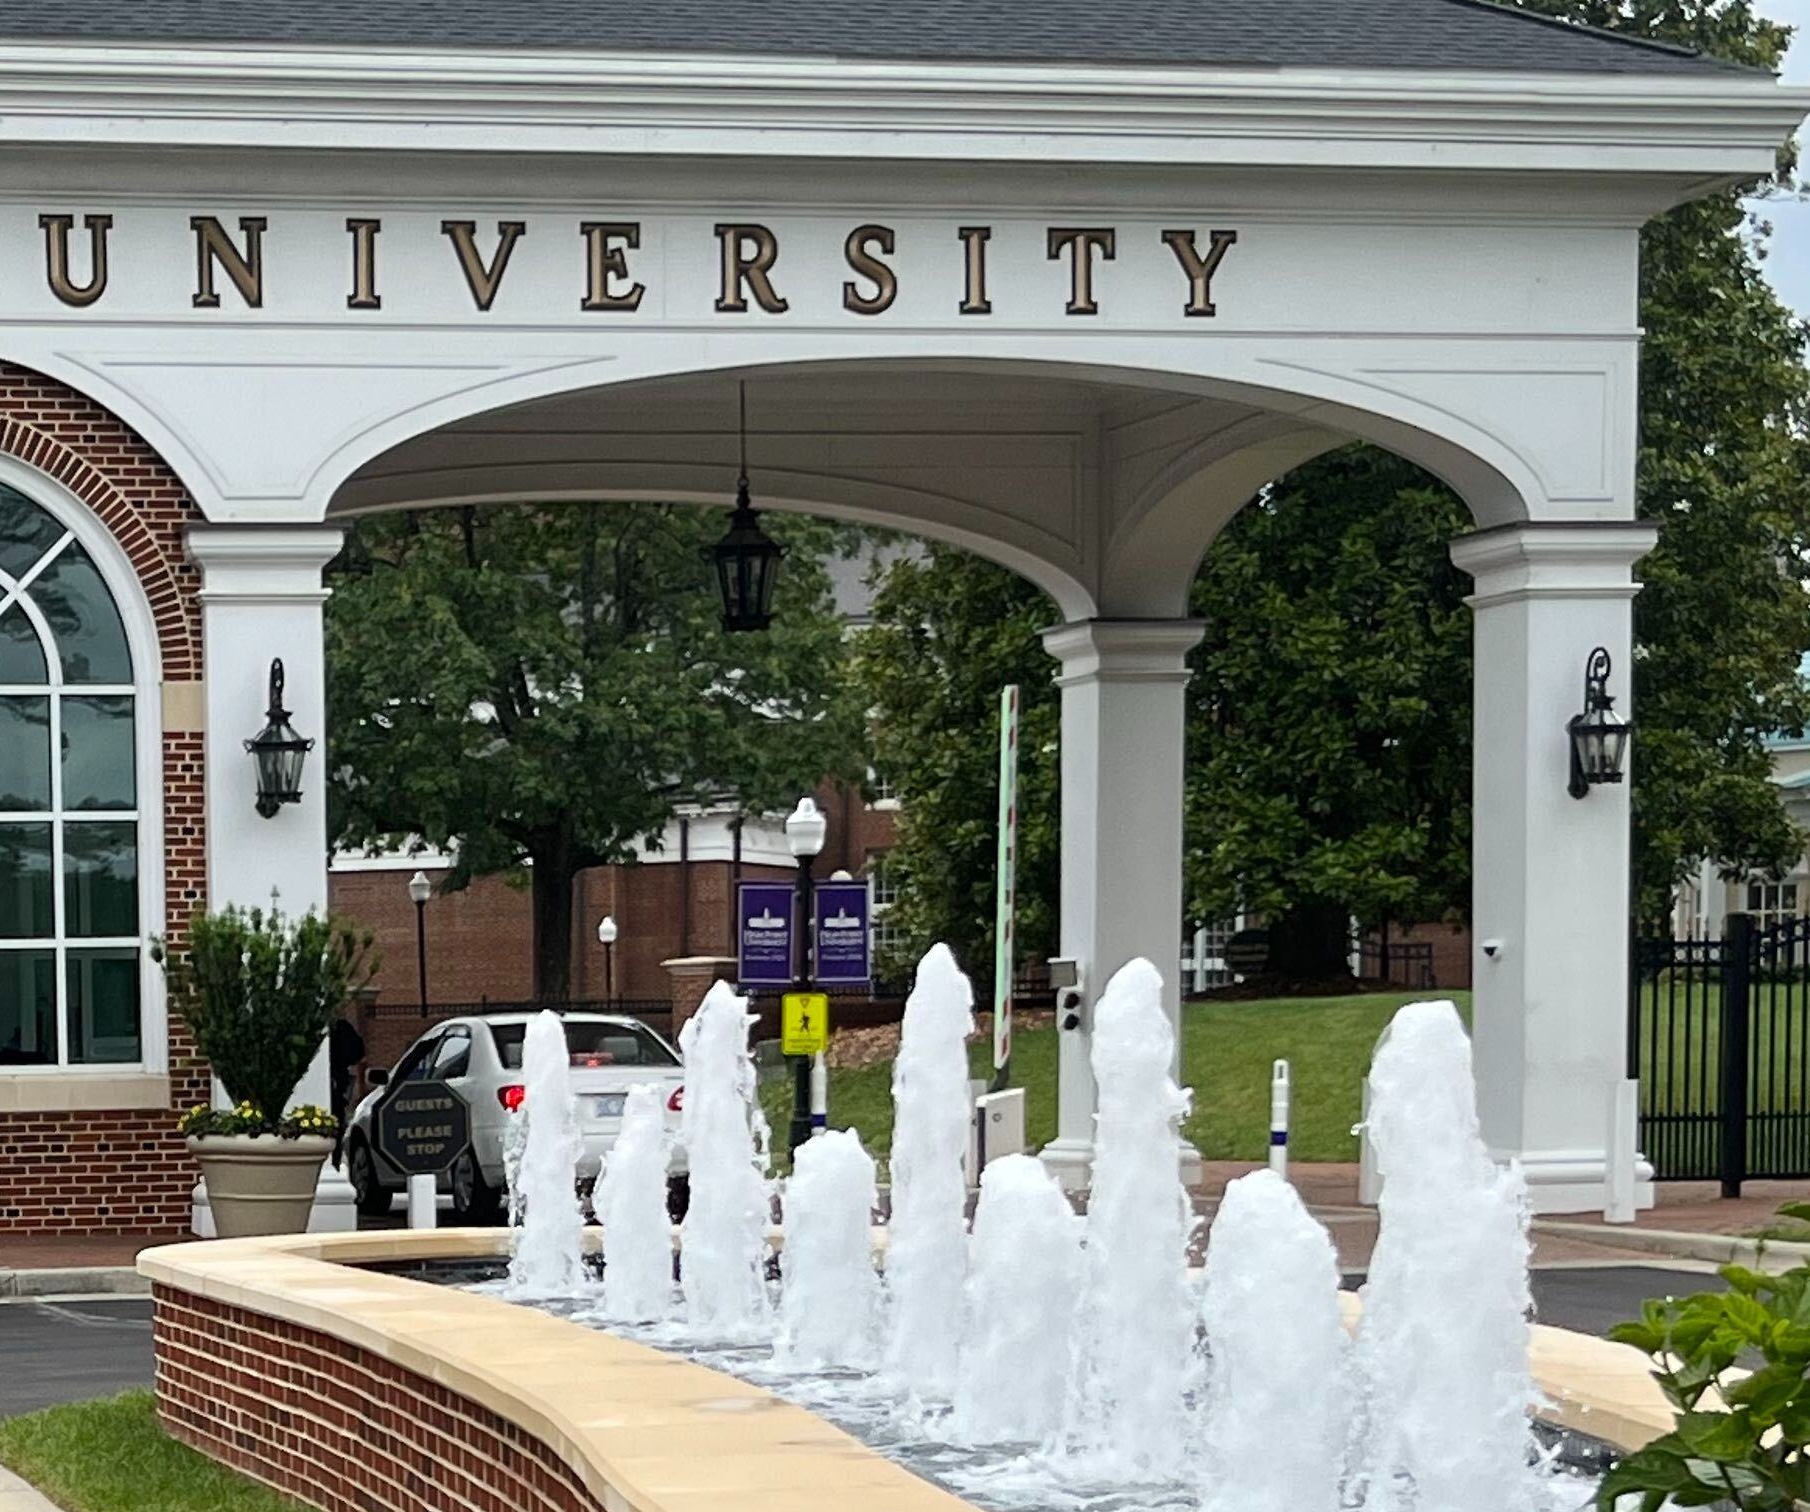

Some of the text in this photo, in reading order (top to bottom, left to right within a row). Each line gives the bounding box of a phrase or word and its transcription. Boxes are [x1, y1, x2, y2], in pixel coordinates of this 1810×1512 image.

[37, 213, 1238, 318] UNIVERSITY
[395, 1098, 454, 1112] GUESTS
[397, 1125, 453, 1139] PLEASE
[406, 1142, 445, 1156] STOP
